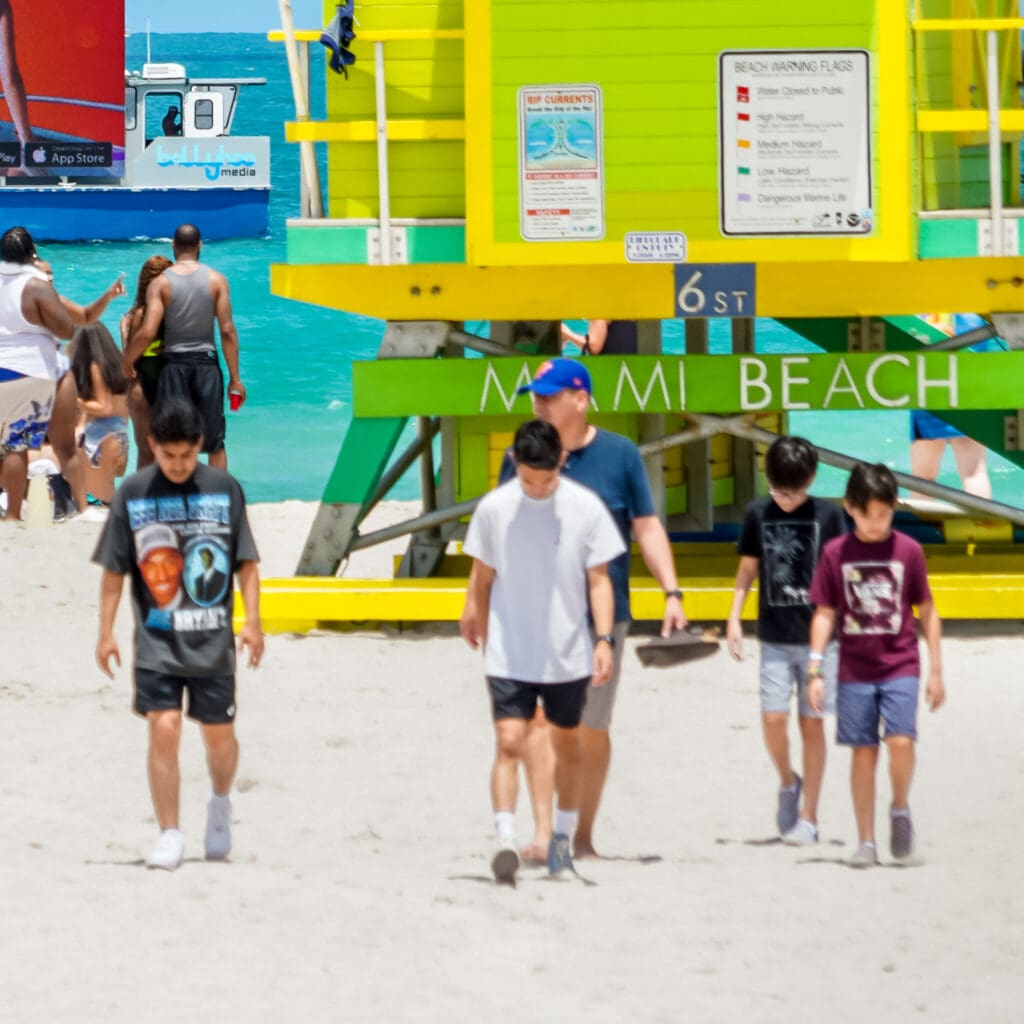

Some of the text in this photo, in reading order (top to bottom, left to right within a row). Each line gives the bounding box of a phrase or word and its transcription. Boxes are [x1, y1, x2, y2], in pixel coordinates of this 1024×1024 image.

[734, 59, 854, 73] BEACH WARNING FLAGS
[782, 86, 810, 96] Closed
[812, 86, 819, 96] to
[821, 86, 845, 96] Public
[527, 94, 593, 104] RIP CURRENTS
[757, 113, 804, 123] High Hazard
[757, 139, 822, 149] Medium Hazard
[52, 152, 105, 165] App Store
[220, 167, 256, 177] media
[757, 166, 810, 176] Low Hazard
[758, 193, 801, 205] Dangerous
[804, 193, 831, 202] Marine
[679, 271, 748, 314] 6 ST
[479, 353, 959, 413] MMI BEACH
